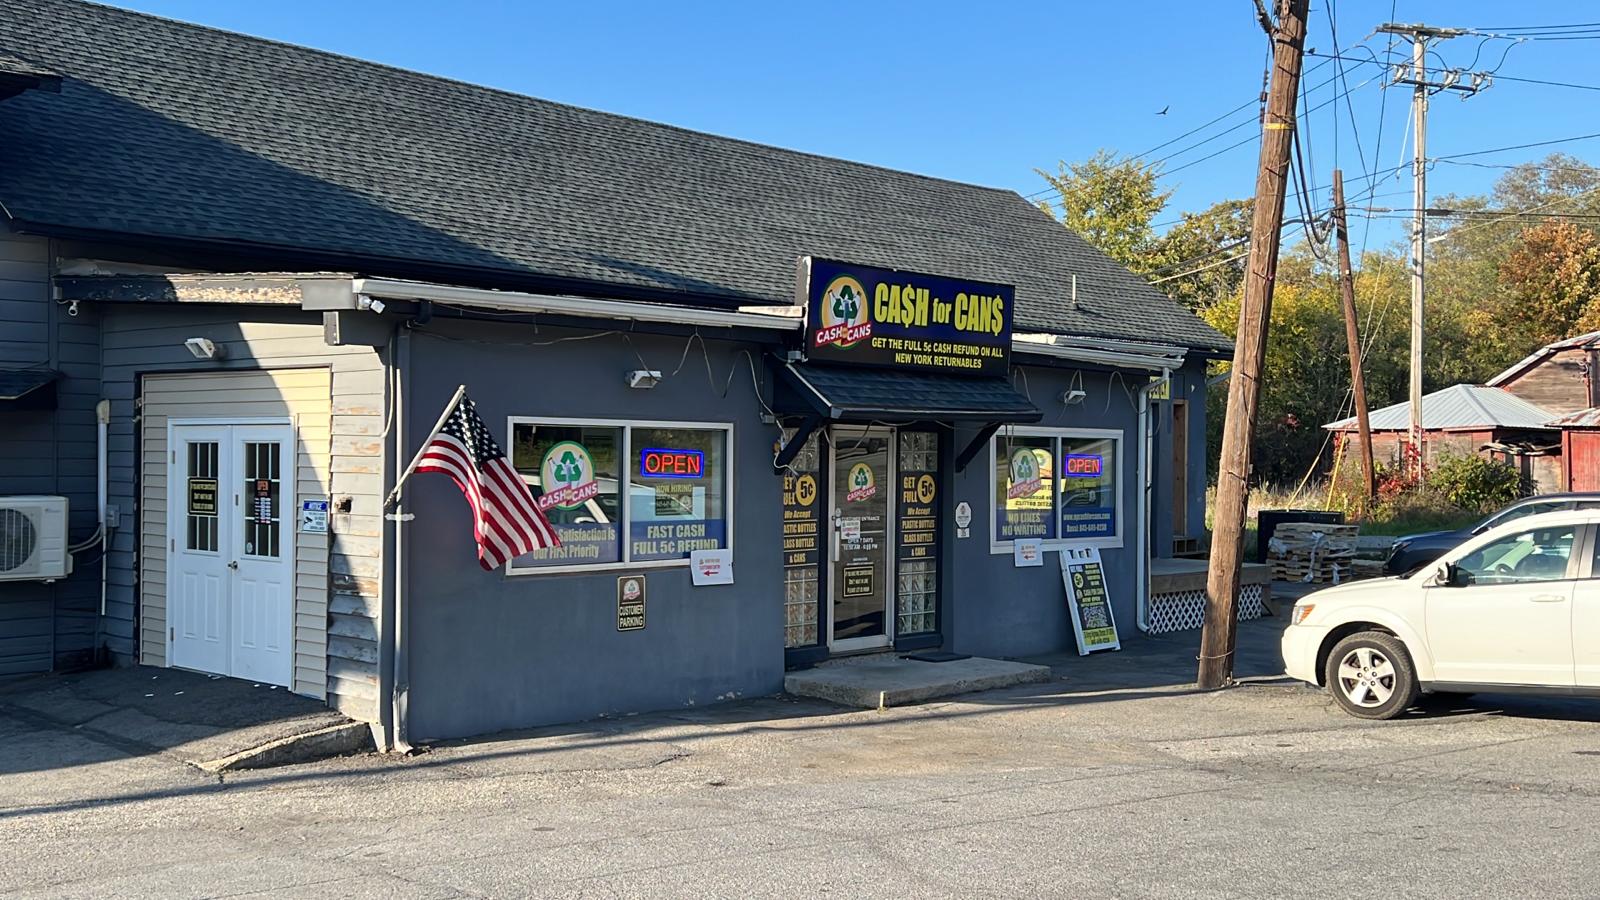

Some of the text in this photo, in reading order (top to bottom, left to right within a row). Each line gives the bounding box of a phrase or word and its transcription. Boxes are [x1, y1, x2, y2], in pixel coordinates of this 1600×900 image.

[874, 282, 1004, 336] CA$H for CAN$
[817, 324, 871, 343] CASH CANS
[872, 337, 887, 348] GET
[889, 339, 902, 349] THE
[904, 340, 921, 351] FULL
[933, 343, 952, 354] CASH
[953, 344, 979, 356] REFUND
[981, 347, 990, 356] ON
[991, 348, 1003, 357] ALL
[895, 353, 982, 369] NEW YORK RETURNABLES
[645, 453, 700, 474] OPEN
[1068, 458, 1099, 473] OPEN
[671, 484, 692, 493] HIRING
[784, 476, 813, 498] ET 5¢
[903, 476, 932, 497] GET 5¢
[540, 483, 598, 507] CASH CANS
[784, 492, 796, 505] ULL
[903, 491, 918, 503] FULL
[793, 510, 811, 519] Accept
[915, 508, 930, 516] Accept
[1008, 512, 1041, 524] NO LINES
[797, 523, 816, 533] BOTTLES
[902, 520, 934, 529] PLASTIC BOTTLES
[1002, 524, 1046, 535] NO WAITING
[559, 527, 606, 542] Satisfaction
[647, 524, 705, 538] FAST CASH
[796, 538, 814, 548] BOTTLES
[904, 533, 933, 543] GLASS BOTTLES
[569, 544, 599, 558] Priority
[633, 541, 659, 554] FULL
[660, 541, 676, 554] 5¢
[915, 547, 926, 556] CANS
[794, 553, 806, 563] CANS
[619, 605, 643, 616] CUSTOMER
[619, 616, 643, 627] PARKING
